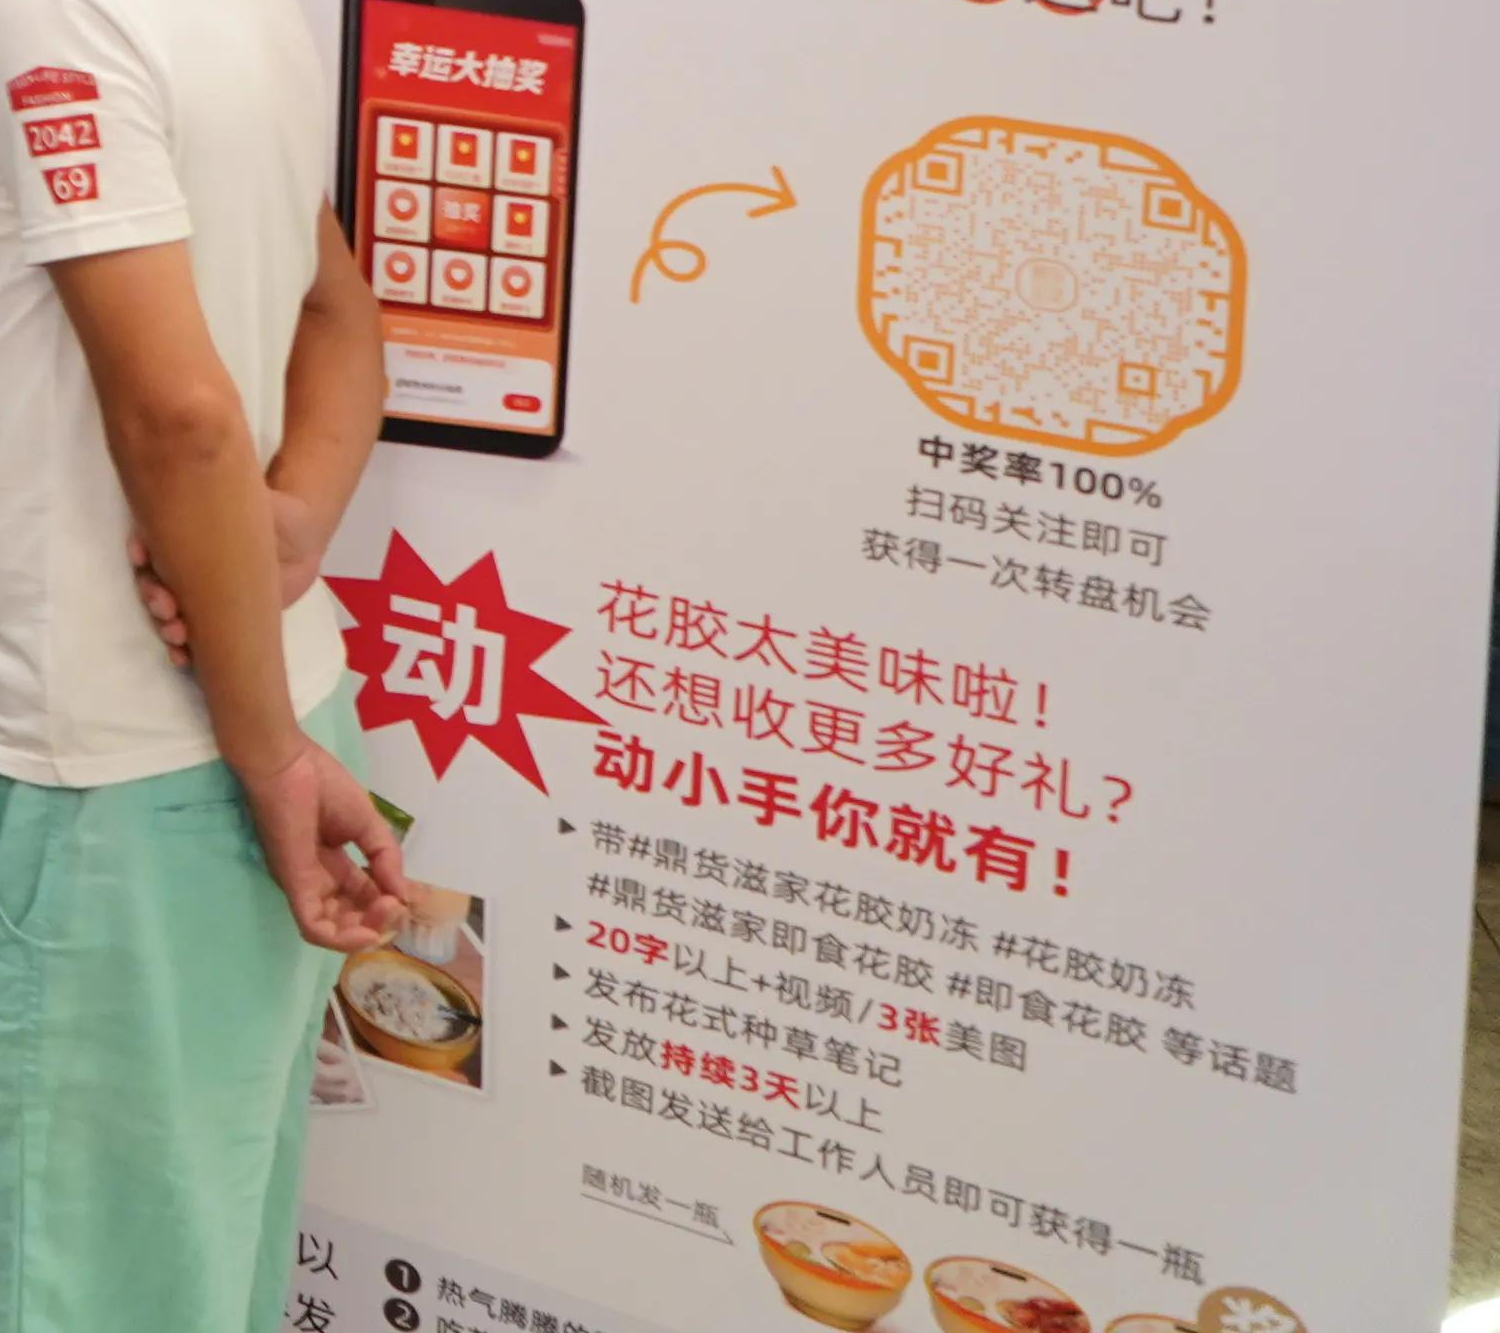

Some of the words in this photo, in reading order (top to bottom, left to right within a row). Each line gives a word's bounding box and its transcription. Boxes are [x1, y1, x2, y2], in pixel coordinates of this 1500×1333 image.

[388, 41, 549, 96] 幸运大抽奖
[30, 119, 94, 152] 2042
[52, 167, 90, 201] 69
[917, 434, 1163, 510] 中奖率100%
[906, 483, 1169, 568] 扫码关注即可
[860, 526, 1212, 633] 获得一次转盘机会
[380, 593, 506, 728] 动
[991, 930, 1196, 1011] #花胶奶冻
[583, 966, 903, 1089] 发布花式种草笔记
[945, 970, 1149, 1054] #即食花胶
[1162, 1026, 1299, 1095] 等话题
[582, 1015, 884, 1134] 发放持续3天以上
[581, 1064, 1206, 1286] 截图发送给工作人员即可获得一瓶
[581, 1162, 721, 1230] 随机发一瓶
